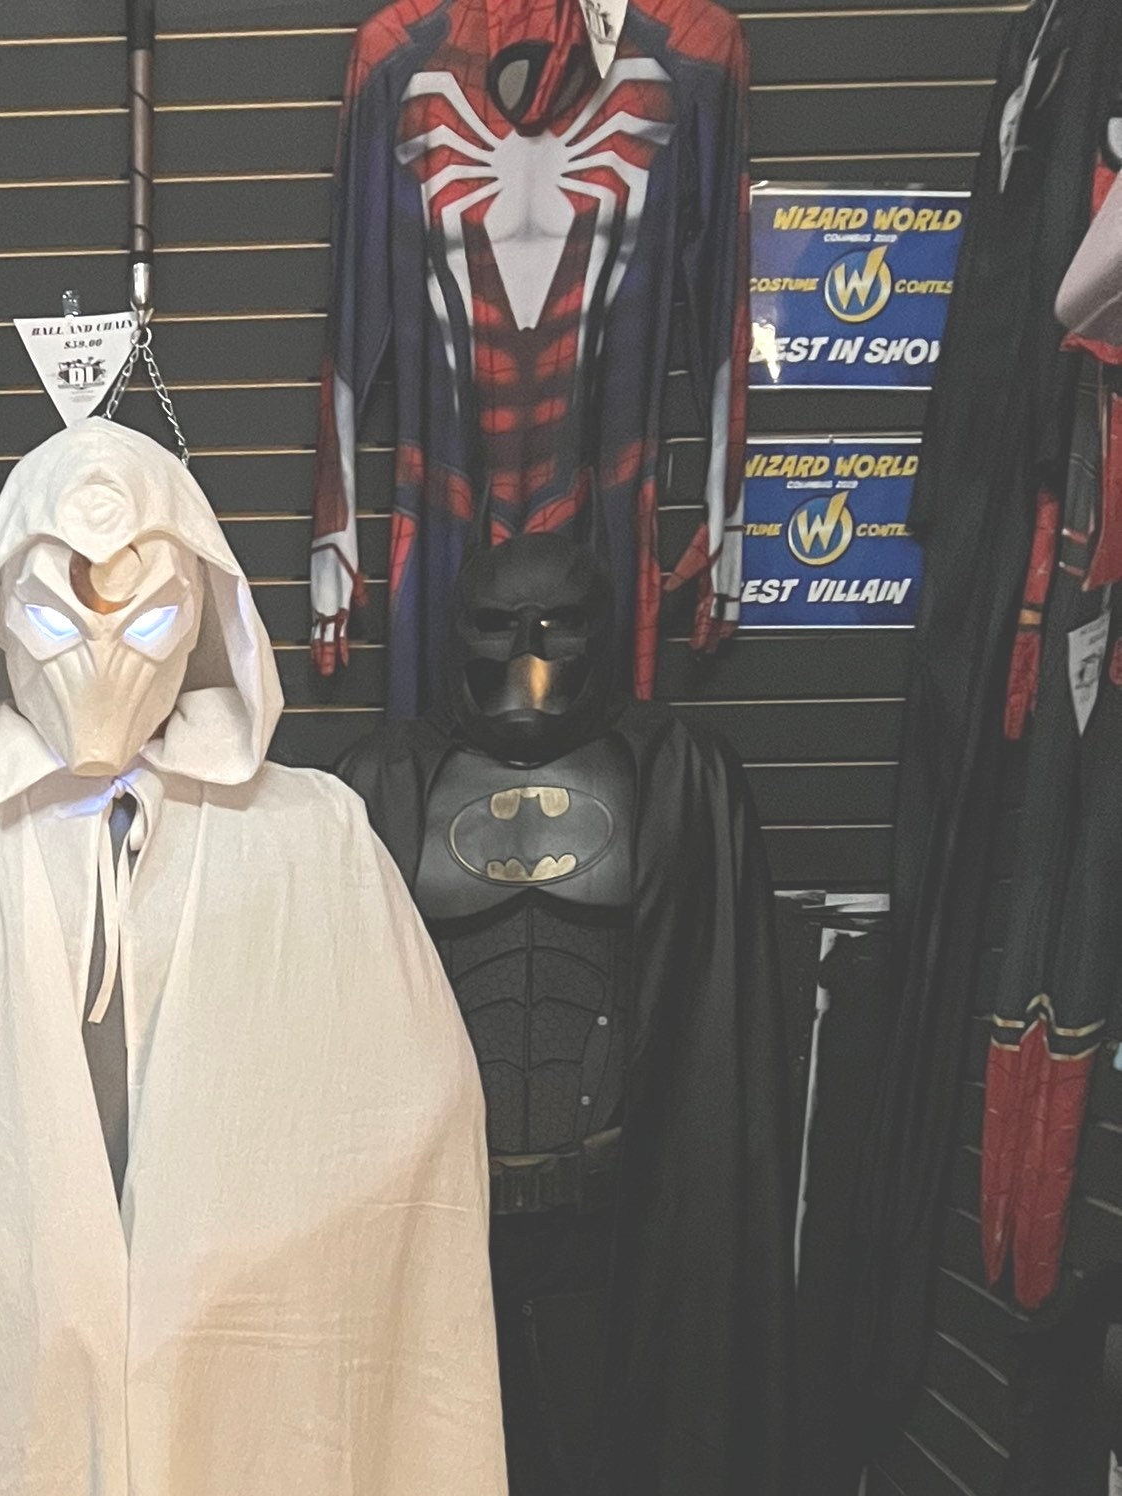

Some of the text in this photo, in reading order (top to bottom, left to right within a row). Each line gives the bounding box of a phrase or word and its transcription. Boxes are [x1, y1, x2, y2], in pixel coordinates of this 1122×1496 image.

[773, 206, 962, 232] WIZARD WORLD
[894, 279, 954, 294] CONTES
[32, 320, 133, 336] BALL AND CHAIN
[828, 337, 864, 364] IN
[834, 454, 919, 478] WORLD
[740, 578, 912, 605] EST VILLAIN
